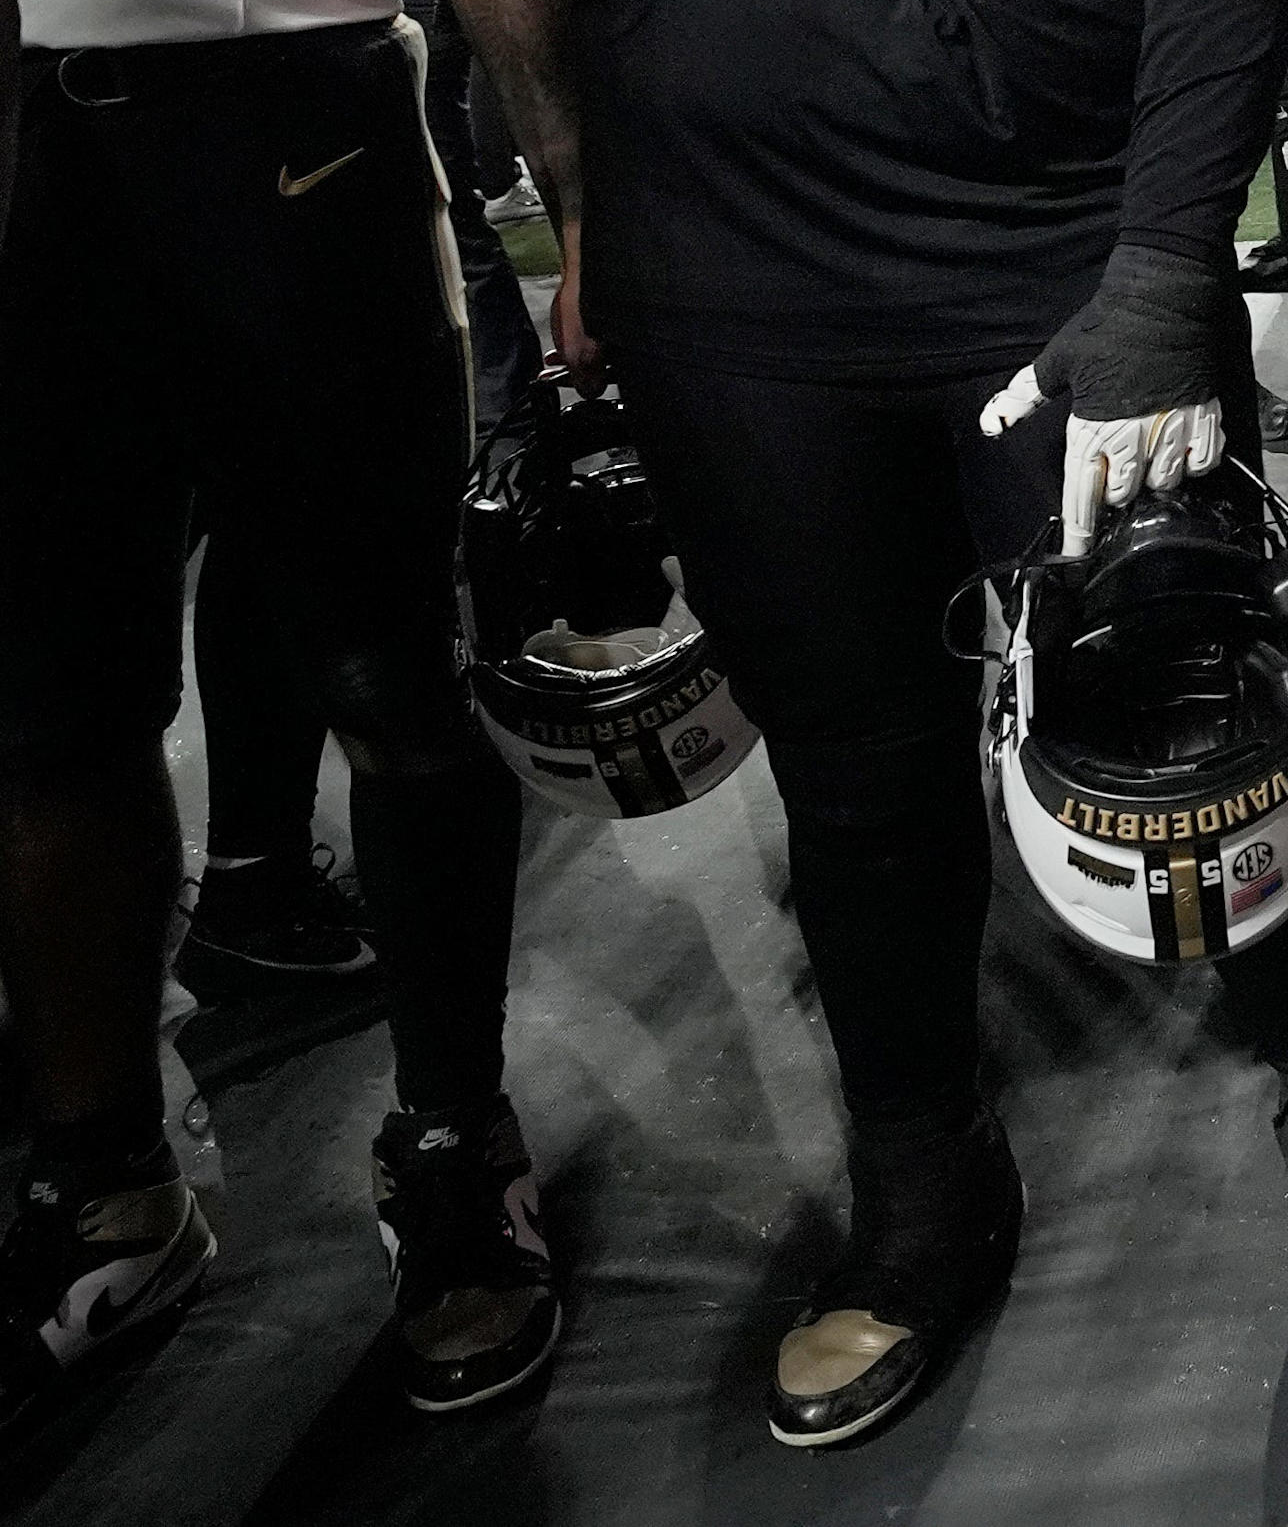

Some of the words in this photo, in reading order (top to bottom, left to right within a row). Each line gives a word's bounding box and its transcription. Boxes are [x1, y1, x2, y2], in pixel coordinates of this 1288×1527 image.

[1201, 859, 1222, 887] 5
[1235, 844, 1273, 880] SEC
[1150, 869, 1169, 894] 5
